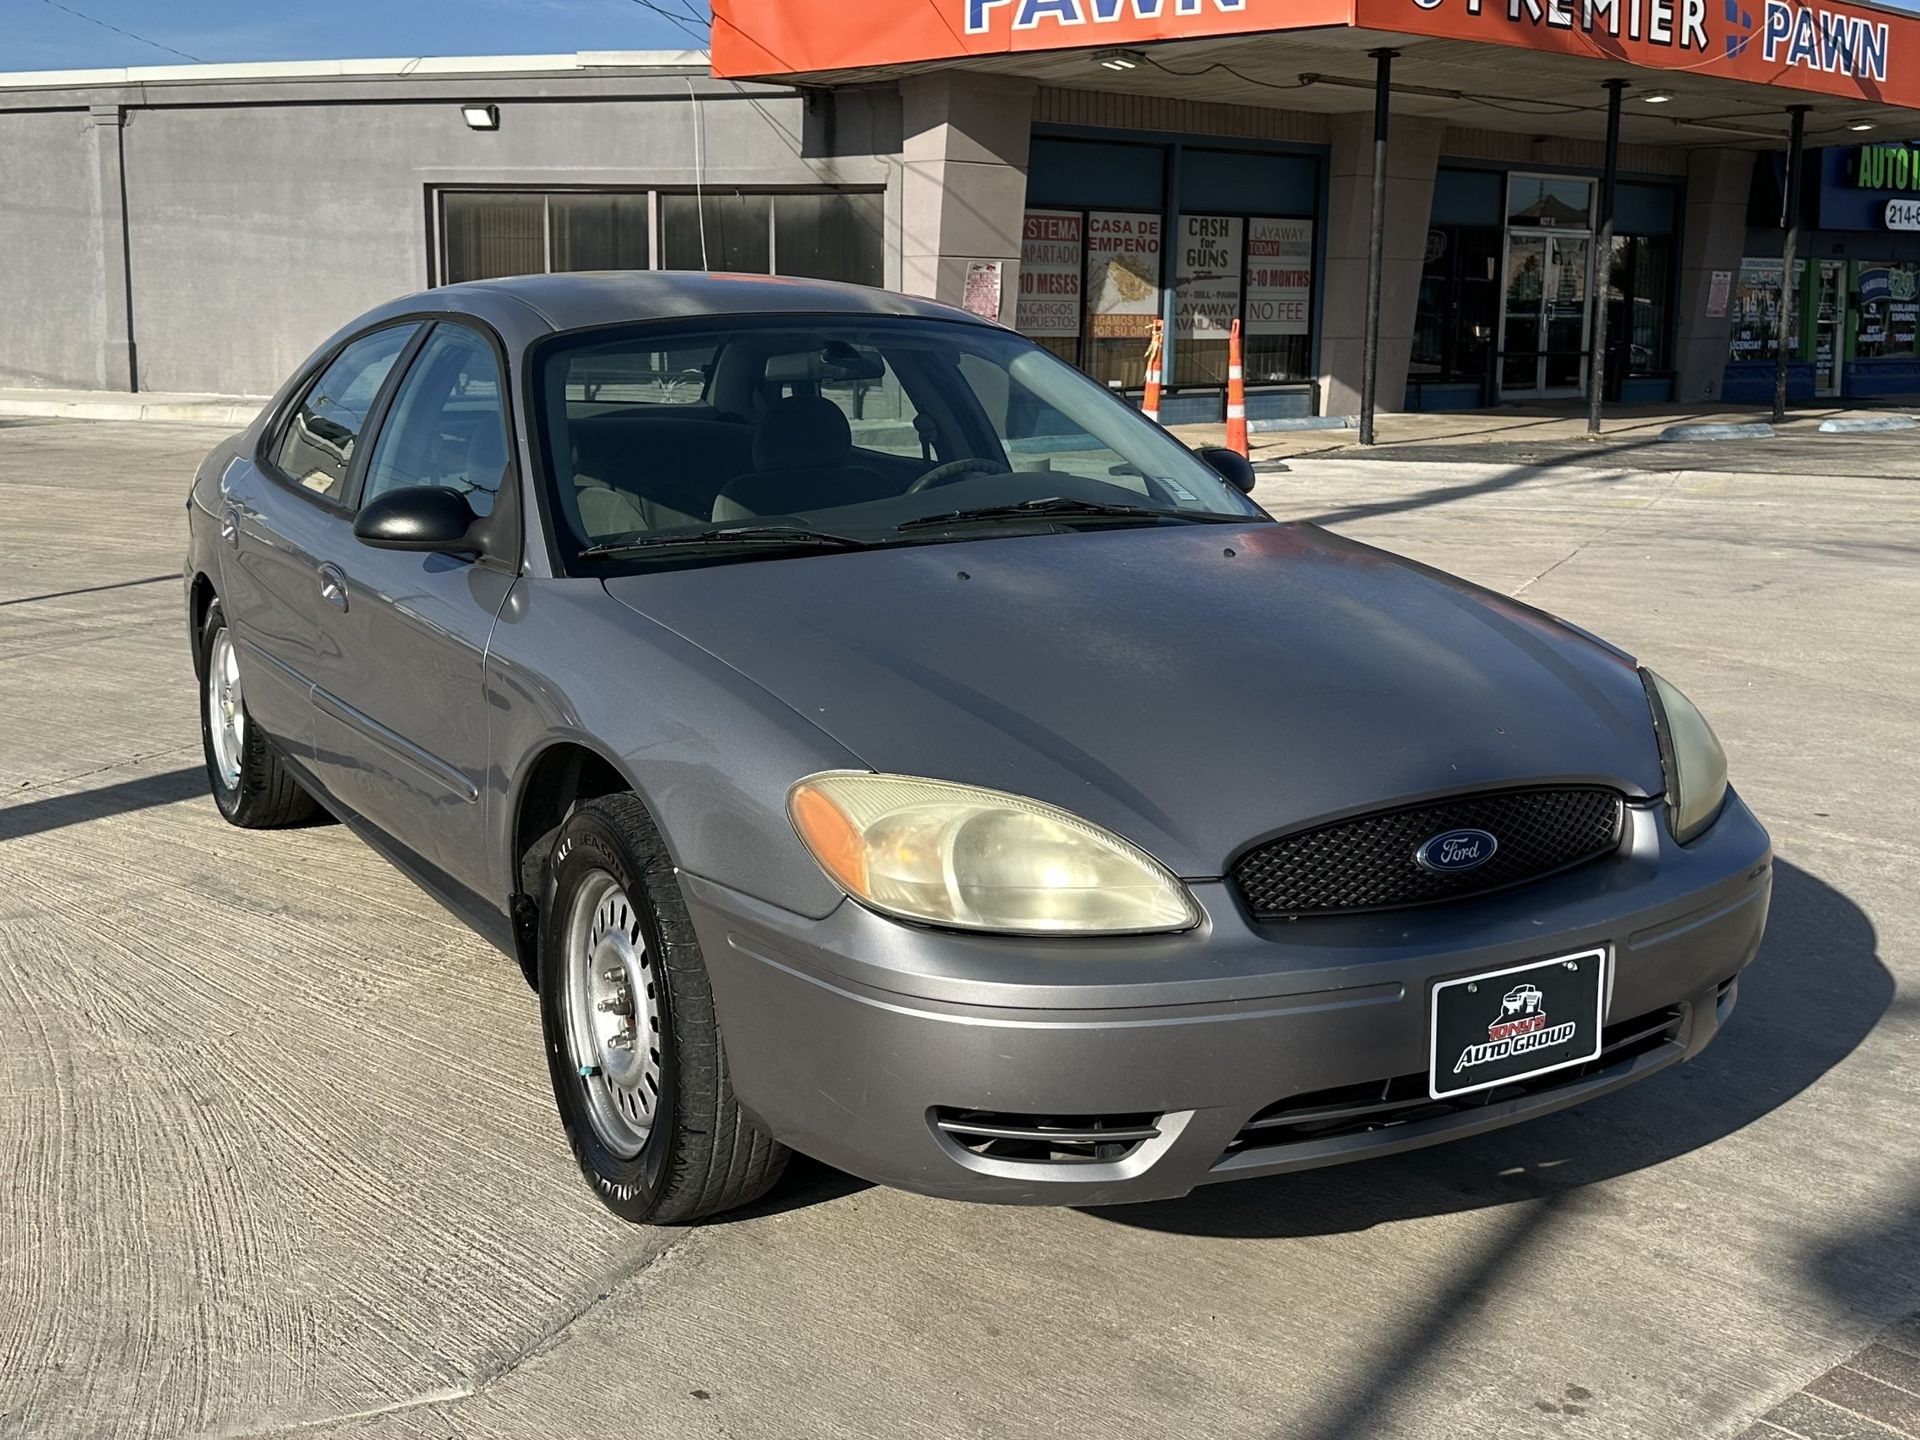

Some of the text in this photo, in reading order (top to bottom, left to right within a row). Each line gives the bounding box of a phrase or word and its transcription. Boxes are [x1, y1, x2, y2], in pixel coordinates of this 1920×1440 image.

[1763, 0, 1889, 82] PAWN
[1858, 145, 1909, 190] AUTO
[1024, 218, 1079, 240] STEMA
[1090, 219, 1159, 235] CASA DE
[1189, 218, 1230, 238] CASH
[1254, 226, 1305, 241] LAYAWAY
[1088, 236, 1159, 253] EMPEÑO
[1200, 237, 1216, 249] for
[1249, 241, 1279, 255] TODAY
[1186, 249, 1229, 268] GUNS
[1037, 273, 1078, 295] MESES
[1269, 270, 1309, 288] MONTHS
[1029, 303, 1073, 316] CARGOS
[1250, 302, 1304, 320] NO FEE
[1114, 326, 1127, 337] SU
[1130, 326, 1150, 337] ORO
[1175, 317, 1232, 331] AVAILABL
[1440, 836, 1480, 864] Ford
[1487, 1014, 1547, 1042] TONY'S
[1452, 1021, 1576, 1074] AUTO GROUP
